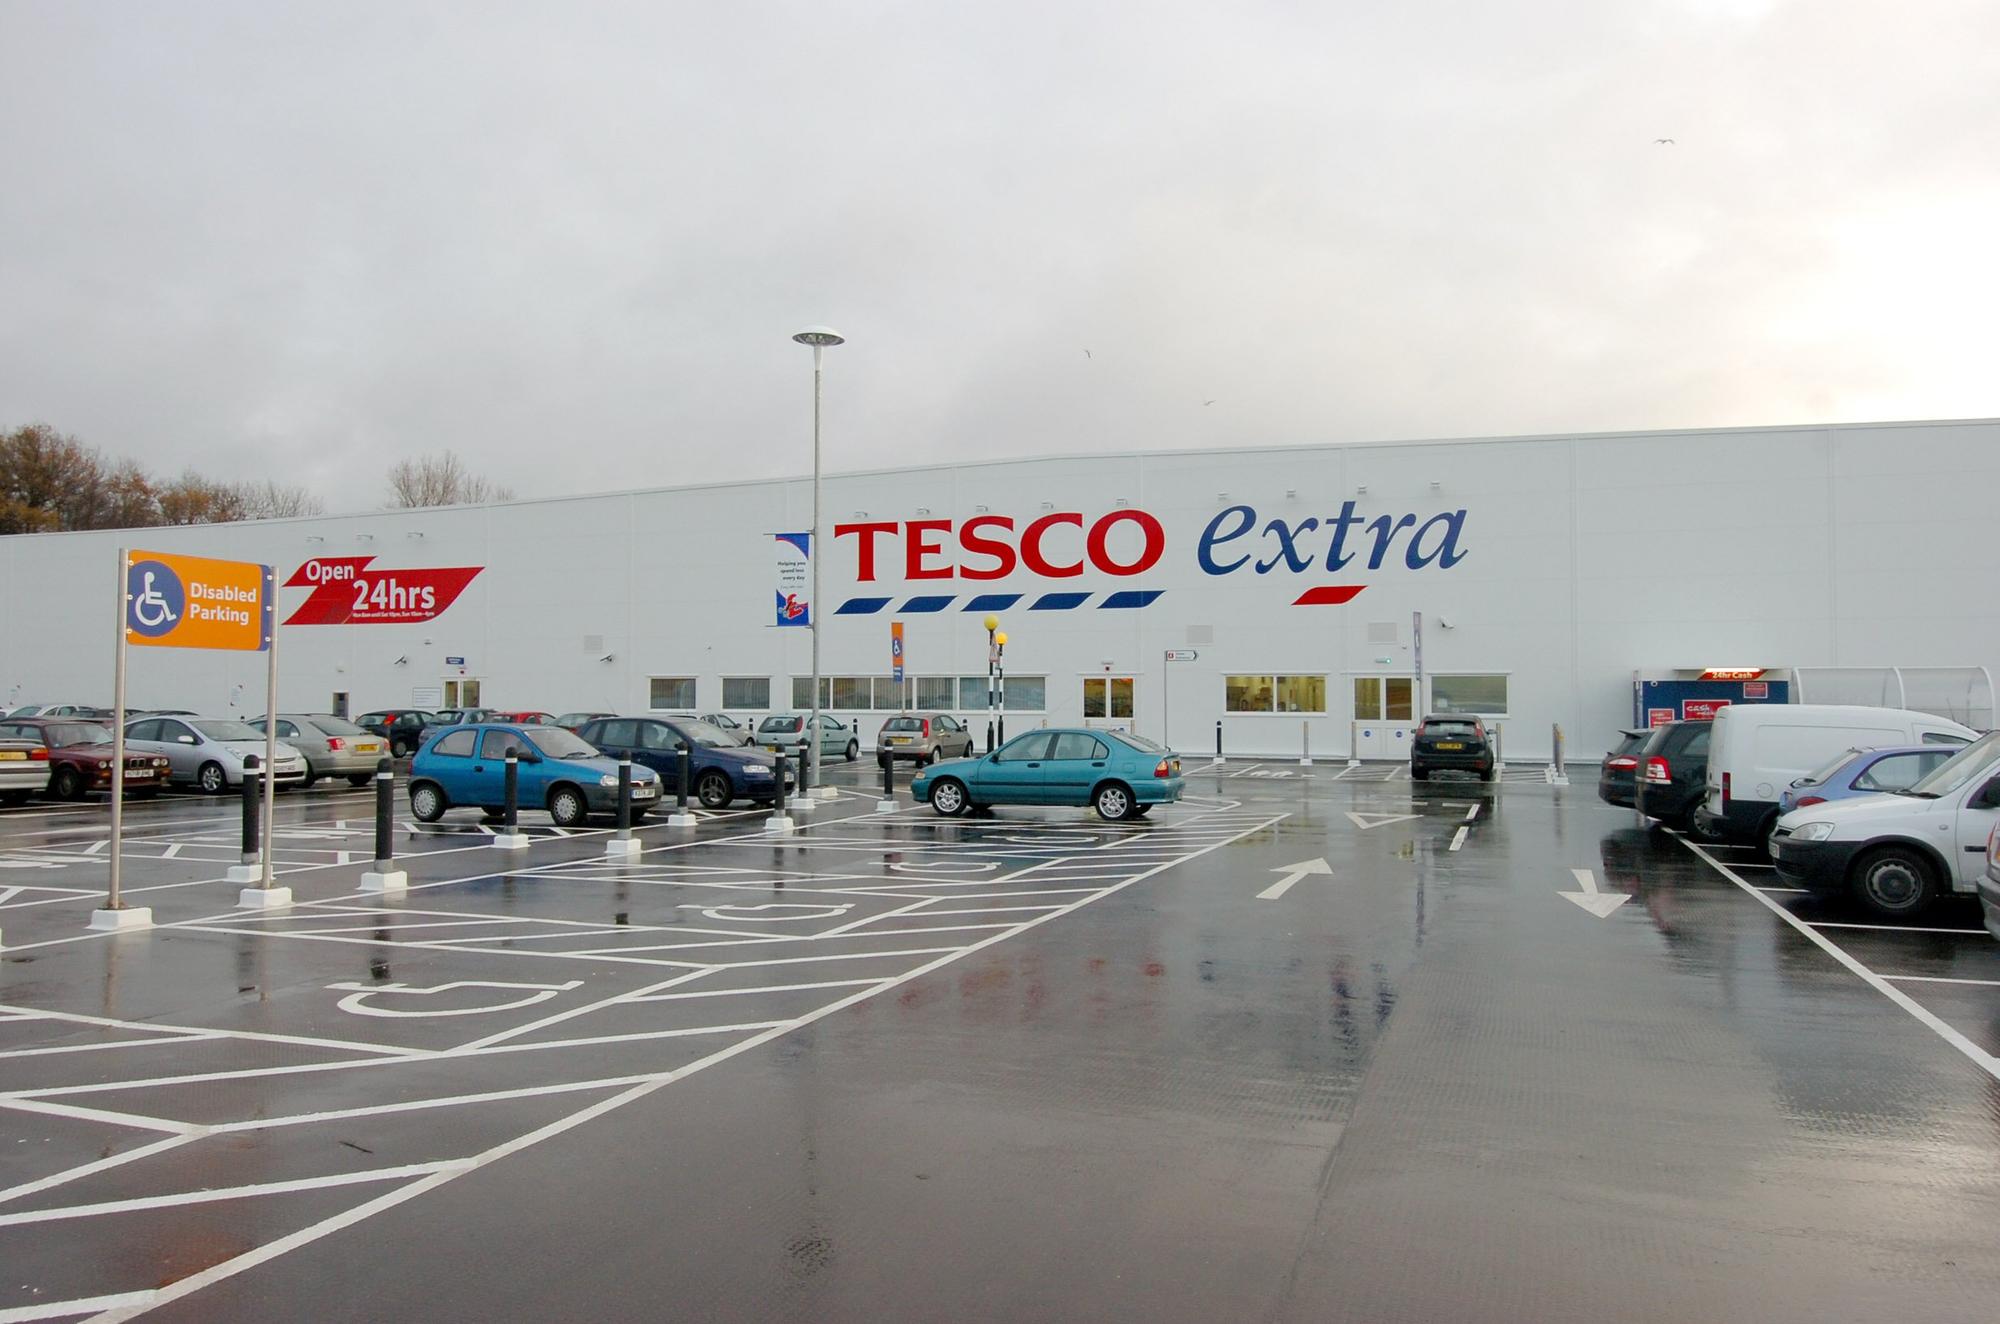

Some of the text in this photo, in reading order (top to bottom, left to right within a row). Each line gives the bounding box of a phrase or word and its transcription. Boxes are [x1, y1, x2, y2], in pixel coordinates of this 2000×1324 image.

[834, 501, 1469, 581] TESCO extra
[306, 561, 354, 584] Open
[190, 582, 257, 602] Disabled
[352, 578, 436, 611] 24hrs
[190, 603, 249, 625] Parking
[1711, 671, 1753, 679] 24hr Cash
